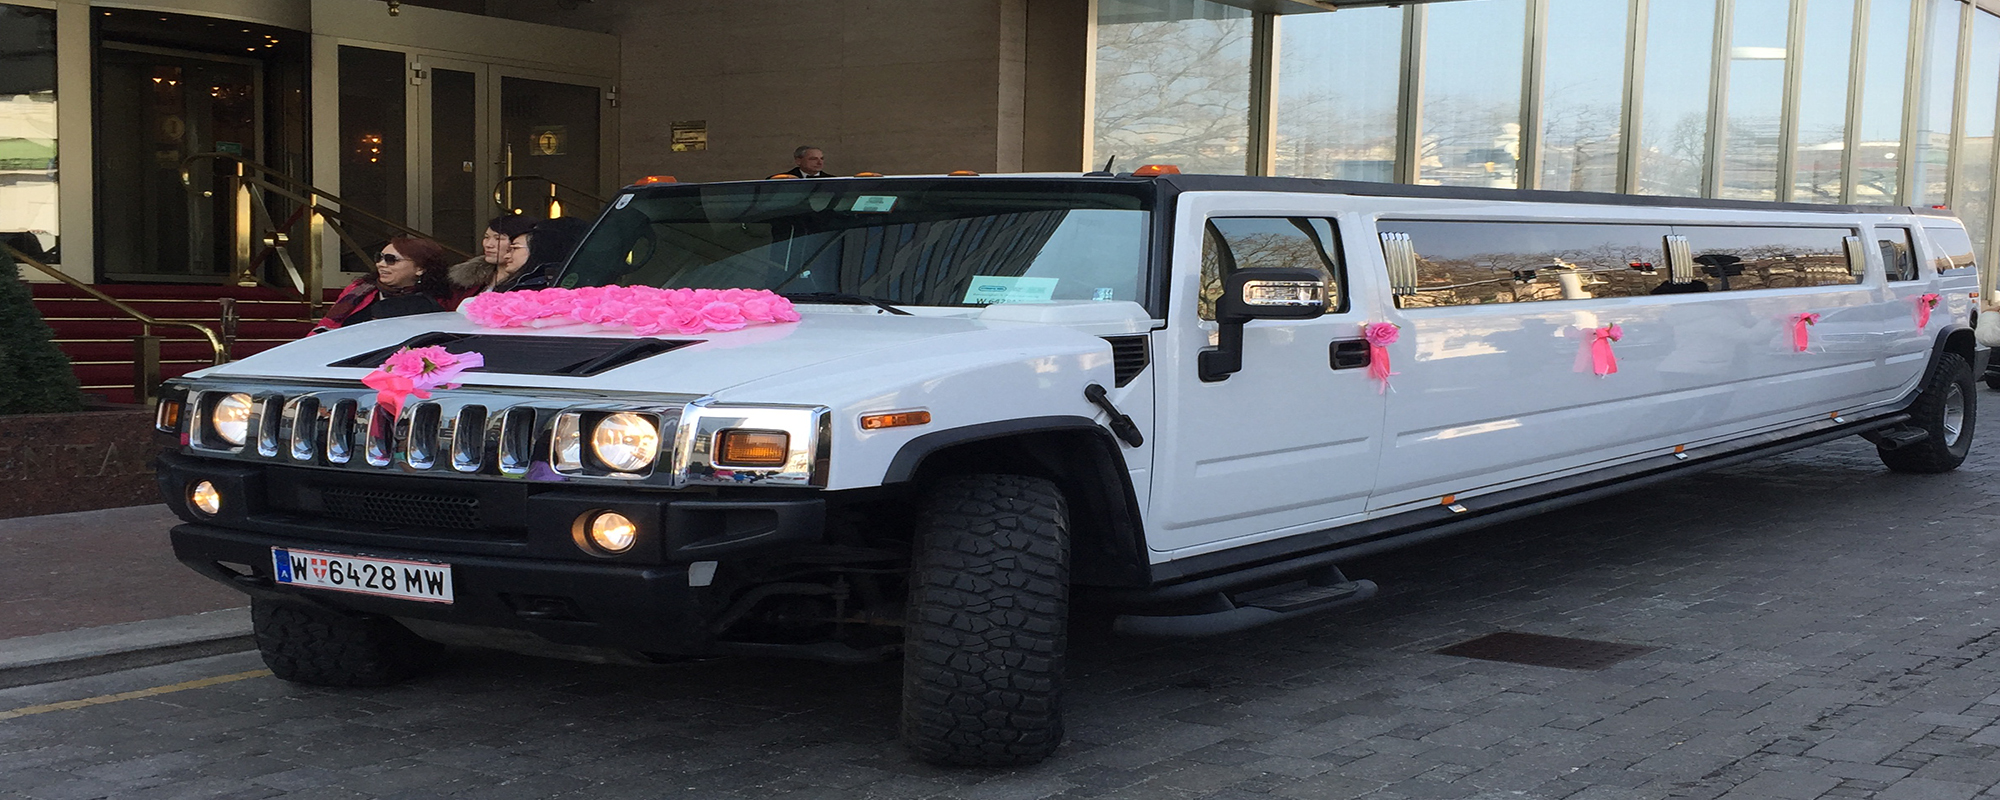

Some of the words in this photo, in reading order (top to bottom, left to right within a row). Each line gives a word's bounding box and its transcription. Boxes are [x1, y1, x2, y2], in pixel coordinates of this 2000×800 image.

[290, 555, 307, 581] W
[329, 560, 397, 591] 6428
[403, 567, 444, 596] MW
